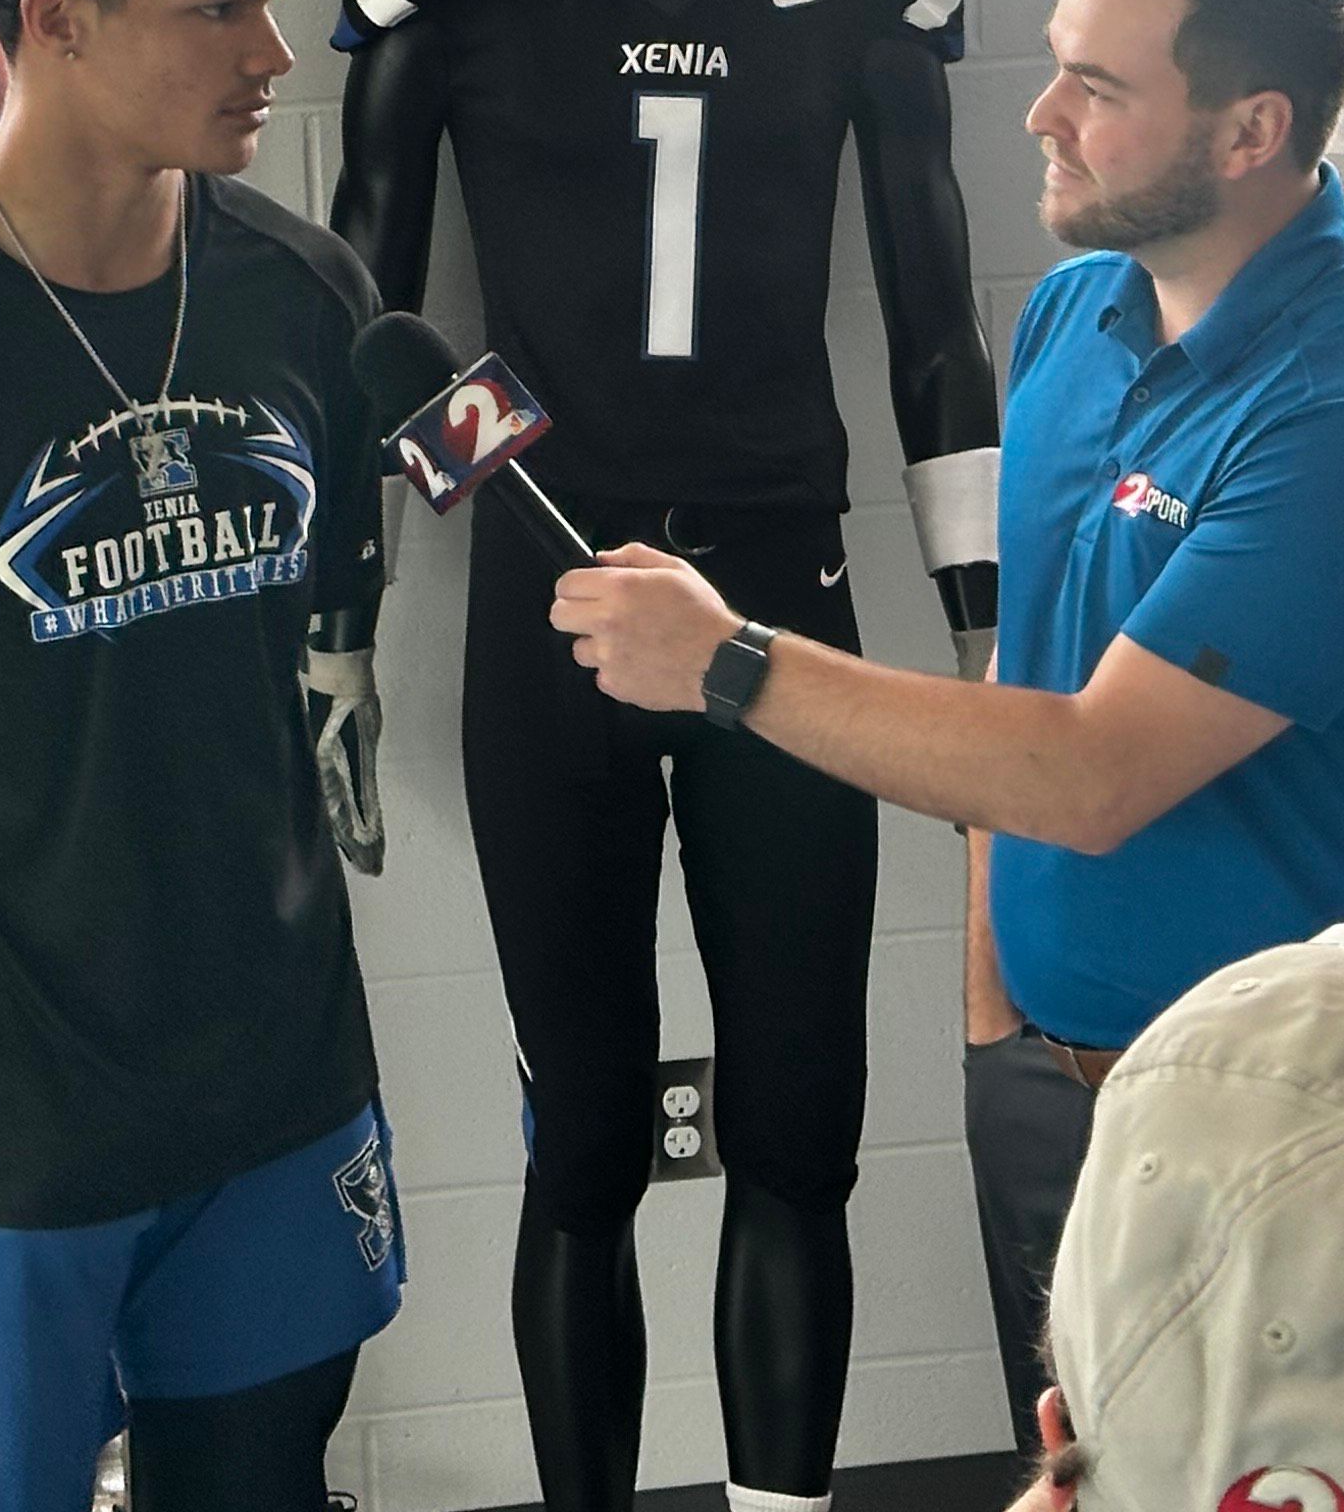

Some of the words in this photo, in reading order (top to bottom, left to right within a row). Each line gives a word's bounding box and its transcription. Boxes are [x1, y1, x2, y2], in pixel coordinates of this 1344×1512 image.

[619, 42, 729, 78] XENIA
[635, 93, 706, 359] 1
[448, 384, 522, 465] 2
[399, 437, 454, 499] 2
[143, 494, 201, 522] XENIA
[61, 501, 281, 598] FOOTBALL
